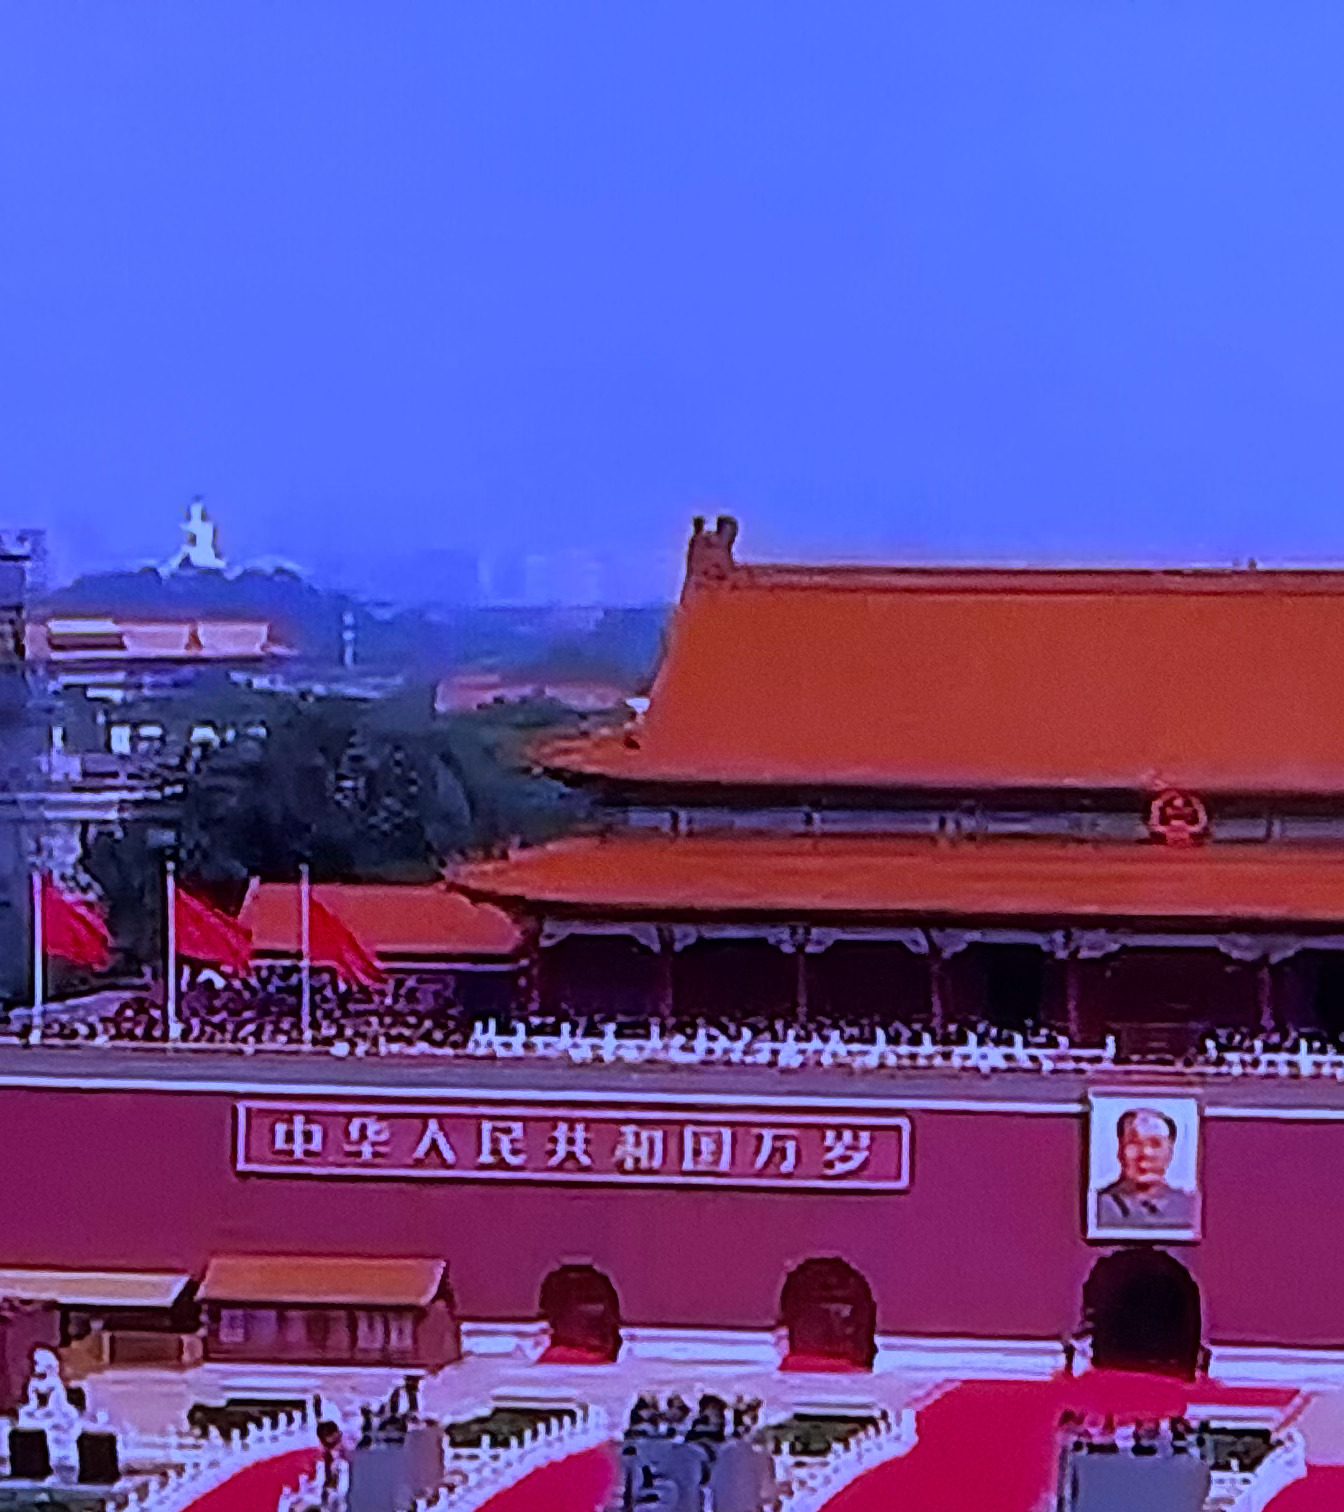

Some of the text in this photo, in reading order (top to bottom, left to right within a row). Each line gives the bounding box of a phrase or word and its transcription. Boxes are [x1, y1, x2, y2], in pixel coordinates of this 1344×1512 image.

[273, 1114, 871, 1176] 中华人民共和国万岁
